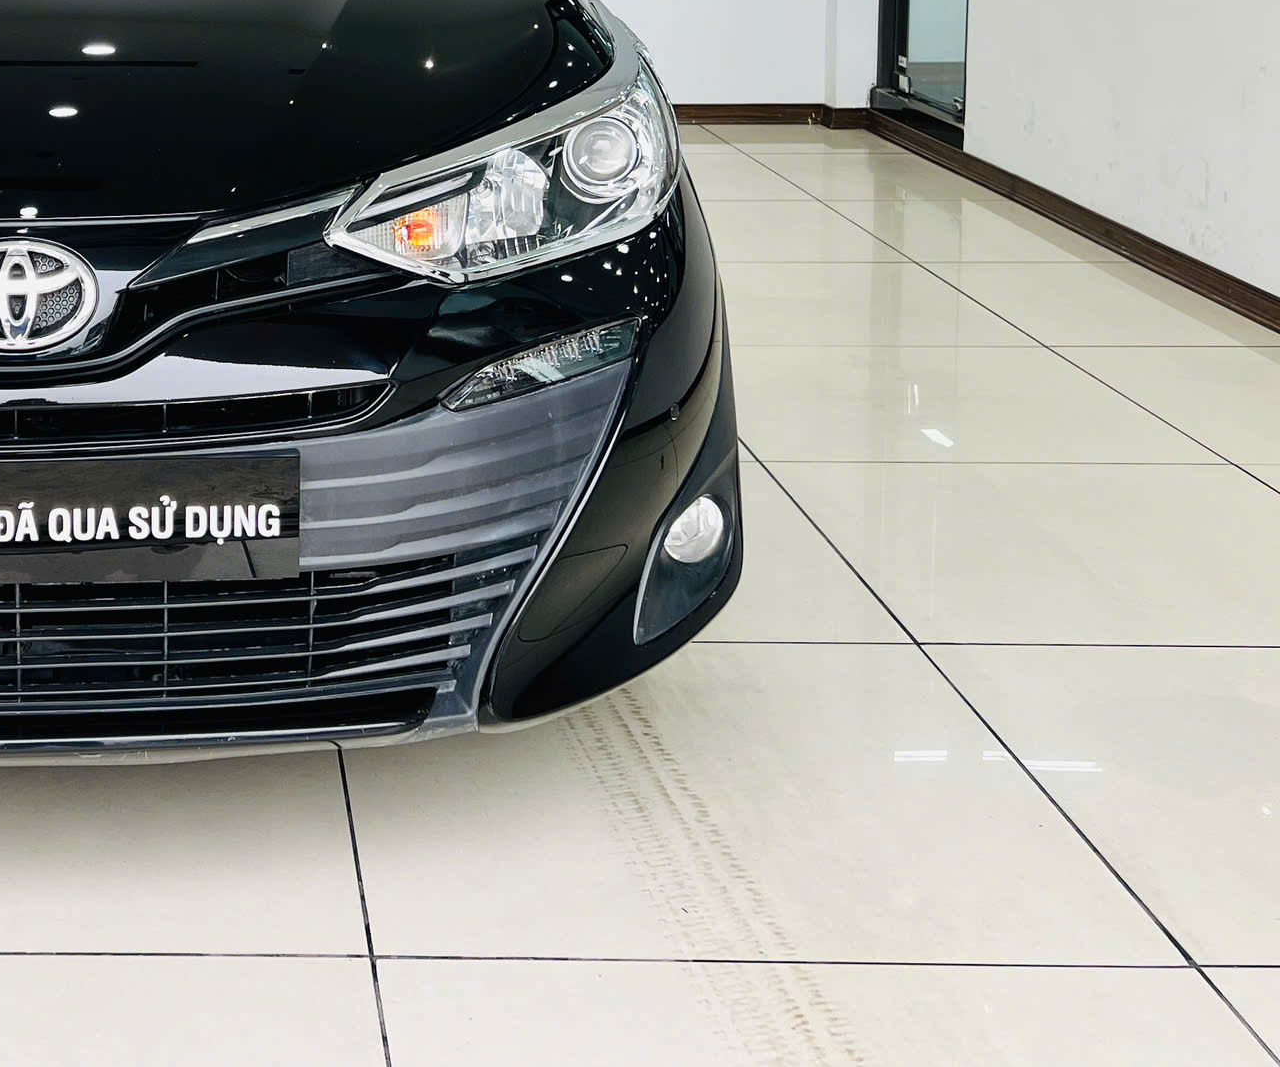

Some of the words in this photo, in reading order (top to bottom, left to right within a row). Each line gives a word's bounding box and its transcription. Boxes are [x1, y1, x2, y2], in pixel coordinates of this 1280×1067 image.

[48, 507, 120, 543] QUA
[128, 494, 178, 540] SỬ
[185, 503, 281, 546] DỤNG
